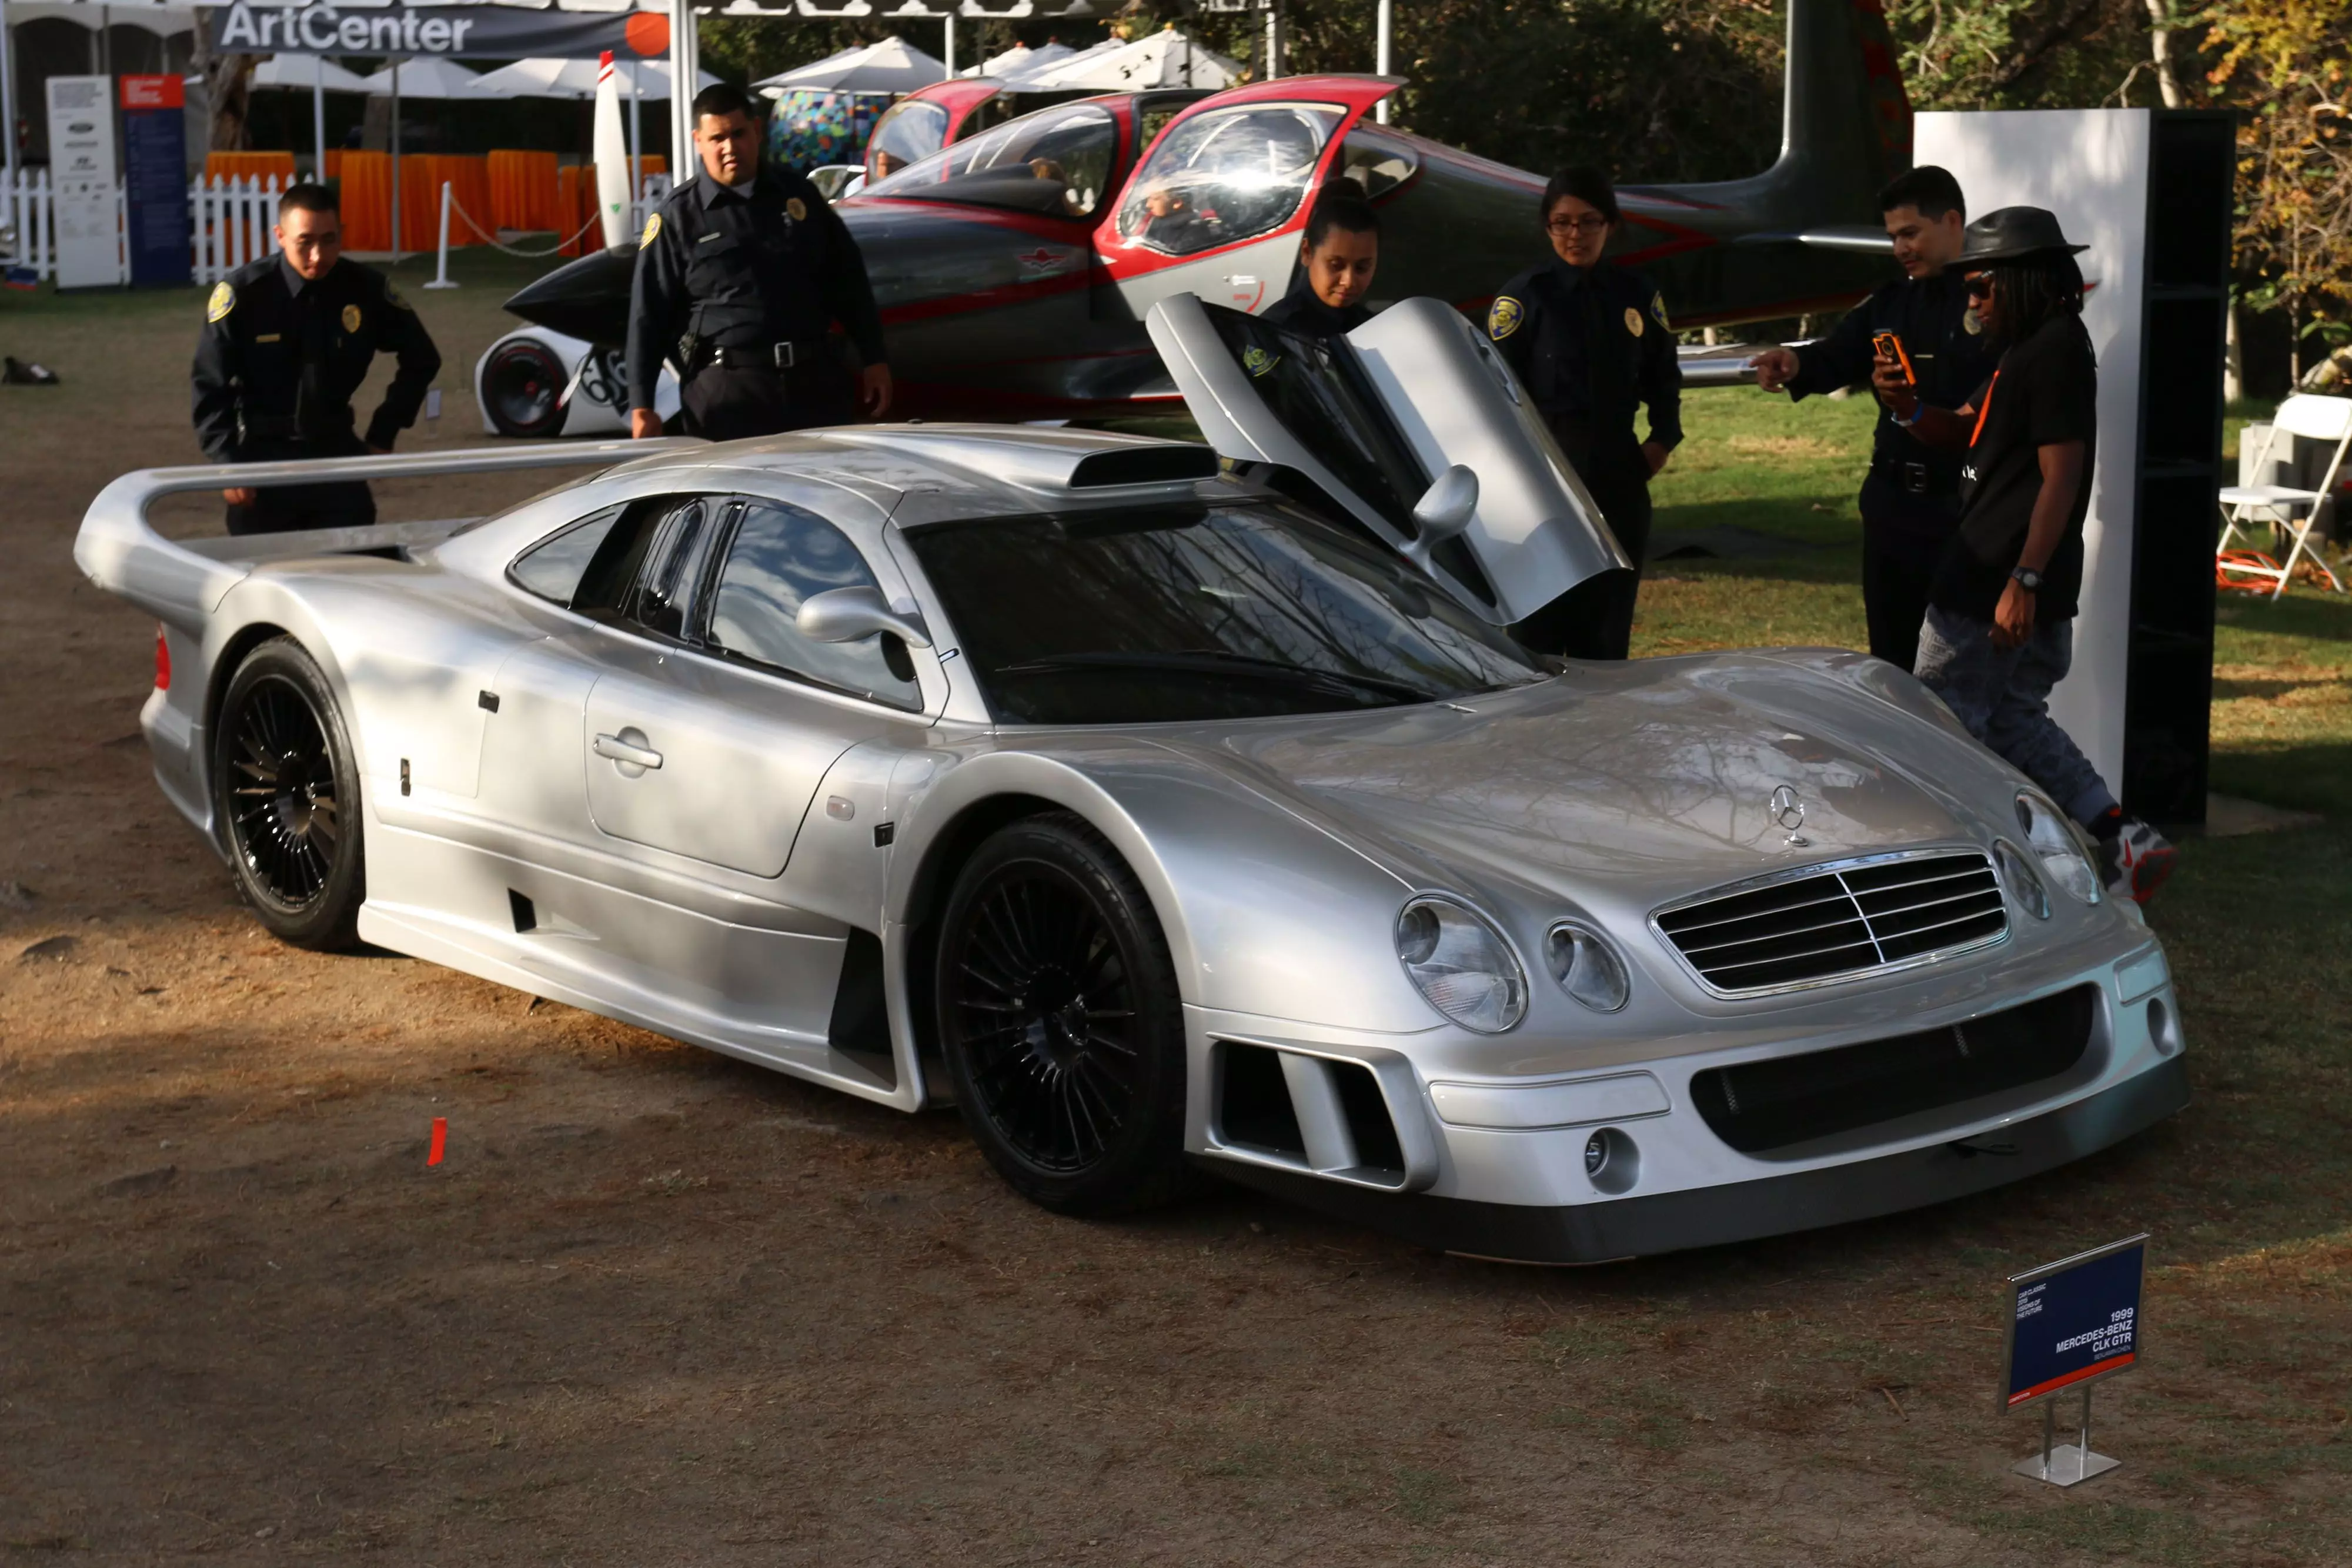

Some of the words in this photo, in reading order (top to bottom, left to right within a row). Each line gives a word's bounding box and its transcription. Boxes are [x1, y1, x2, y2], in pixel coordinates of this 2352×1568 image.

[220, 4, 473, 51] ArtCenter
[2111, 1308, 2133, 1322] 1999
[2056, 1319, 2133, 1353] MERCEDES-BENZ
[2093, 1338, 2110, 1352] CLK
[2112, 1332, 2132, 1346] GTR
